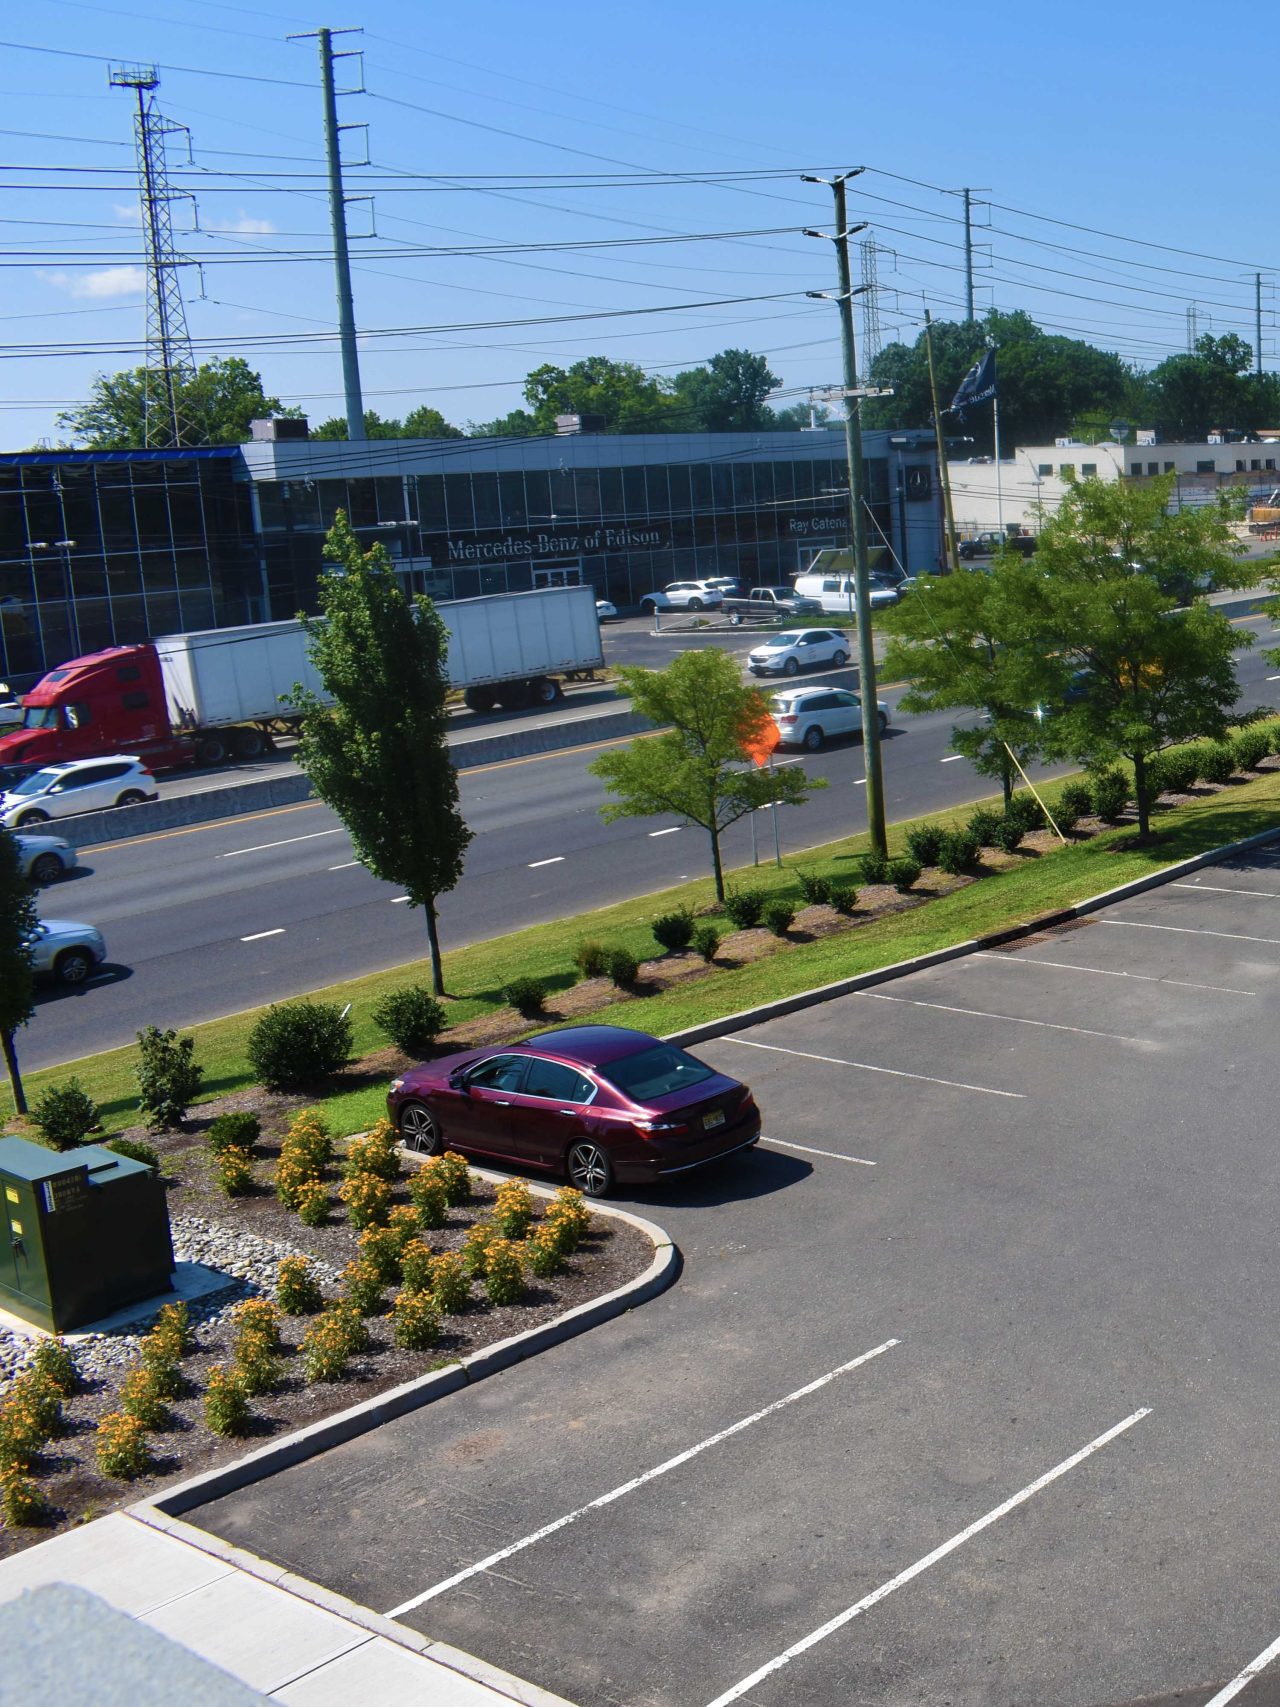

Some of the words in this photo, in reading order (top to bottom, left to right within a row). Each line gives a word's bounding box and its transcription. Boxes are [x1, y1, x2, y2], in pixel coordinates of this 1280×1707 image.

[789, 518, 808, 535] Ray
[811, 517, 848, 530] Catena
[447, 534, 580, 560] Mercedes-Benz
[584, 530, 601, 550] of
[604, 529, 661, 547] Edison
